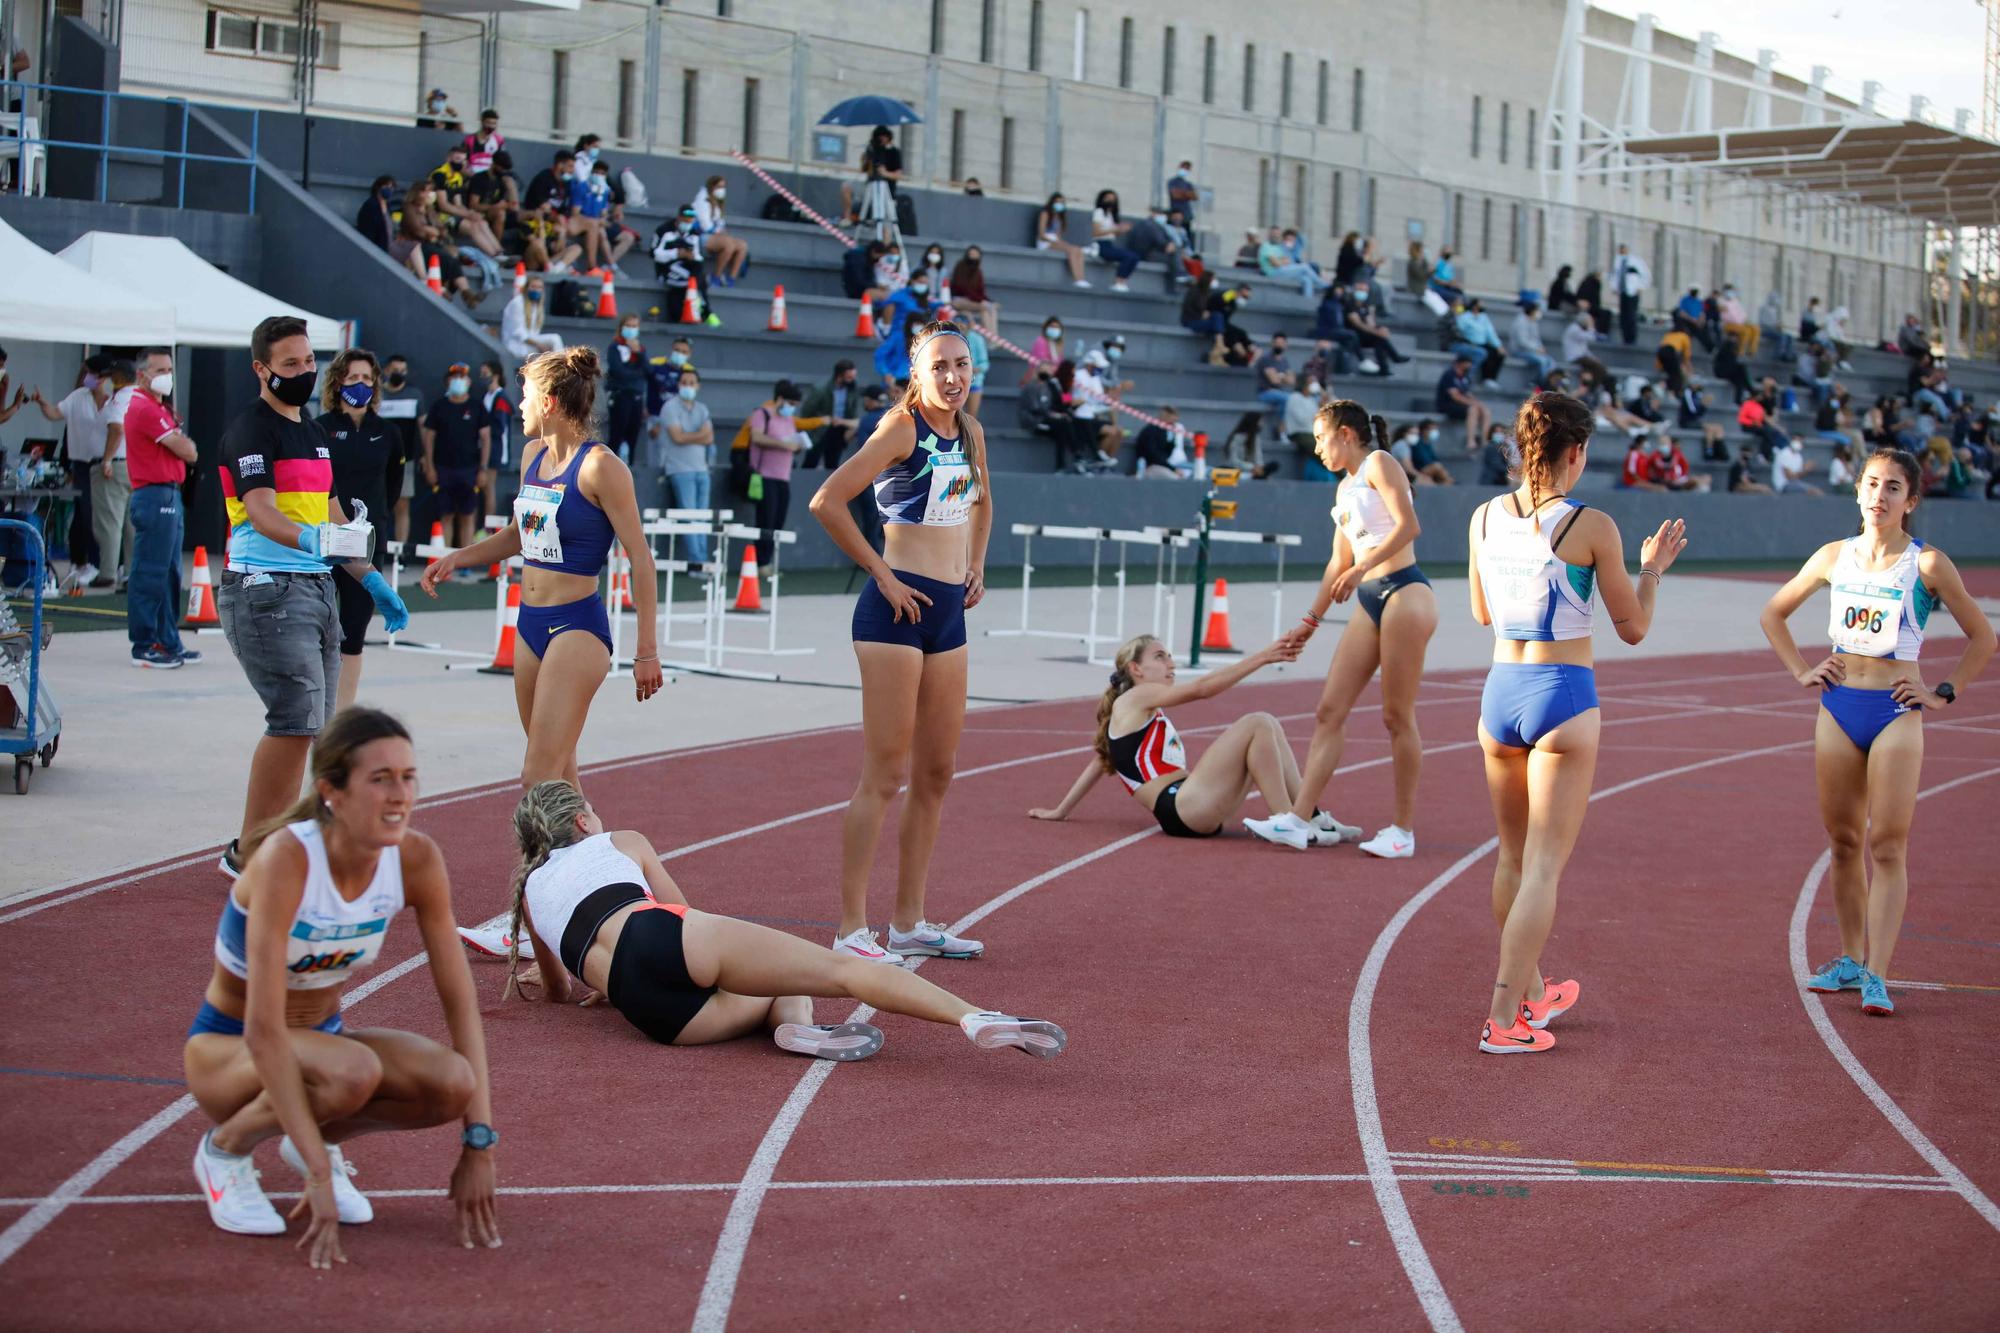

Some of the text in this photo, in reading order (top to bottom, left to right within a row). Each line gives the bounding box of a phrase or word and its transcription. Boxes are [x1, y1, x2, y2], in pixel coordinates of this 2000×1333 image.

[238, 454, 264, 467] 226ERS
[241, 468, 266, 478] DREAMS
[543, 548, 558, 558] 041
[1497, 566, 1534, 577] ELCHE
[1844, 606, 1883, 634] 096
